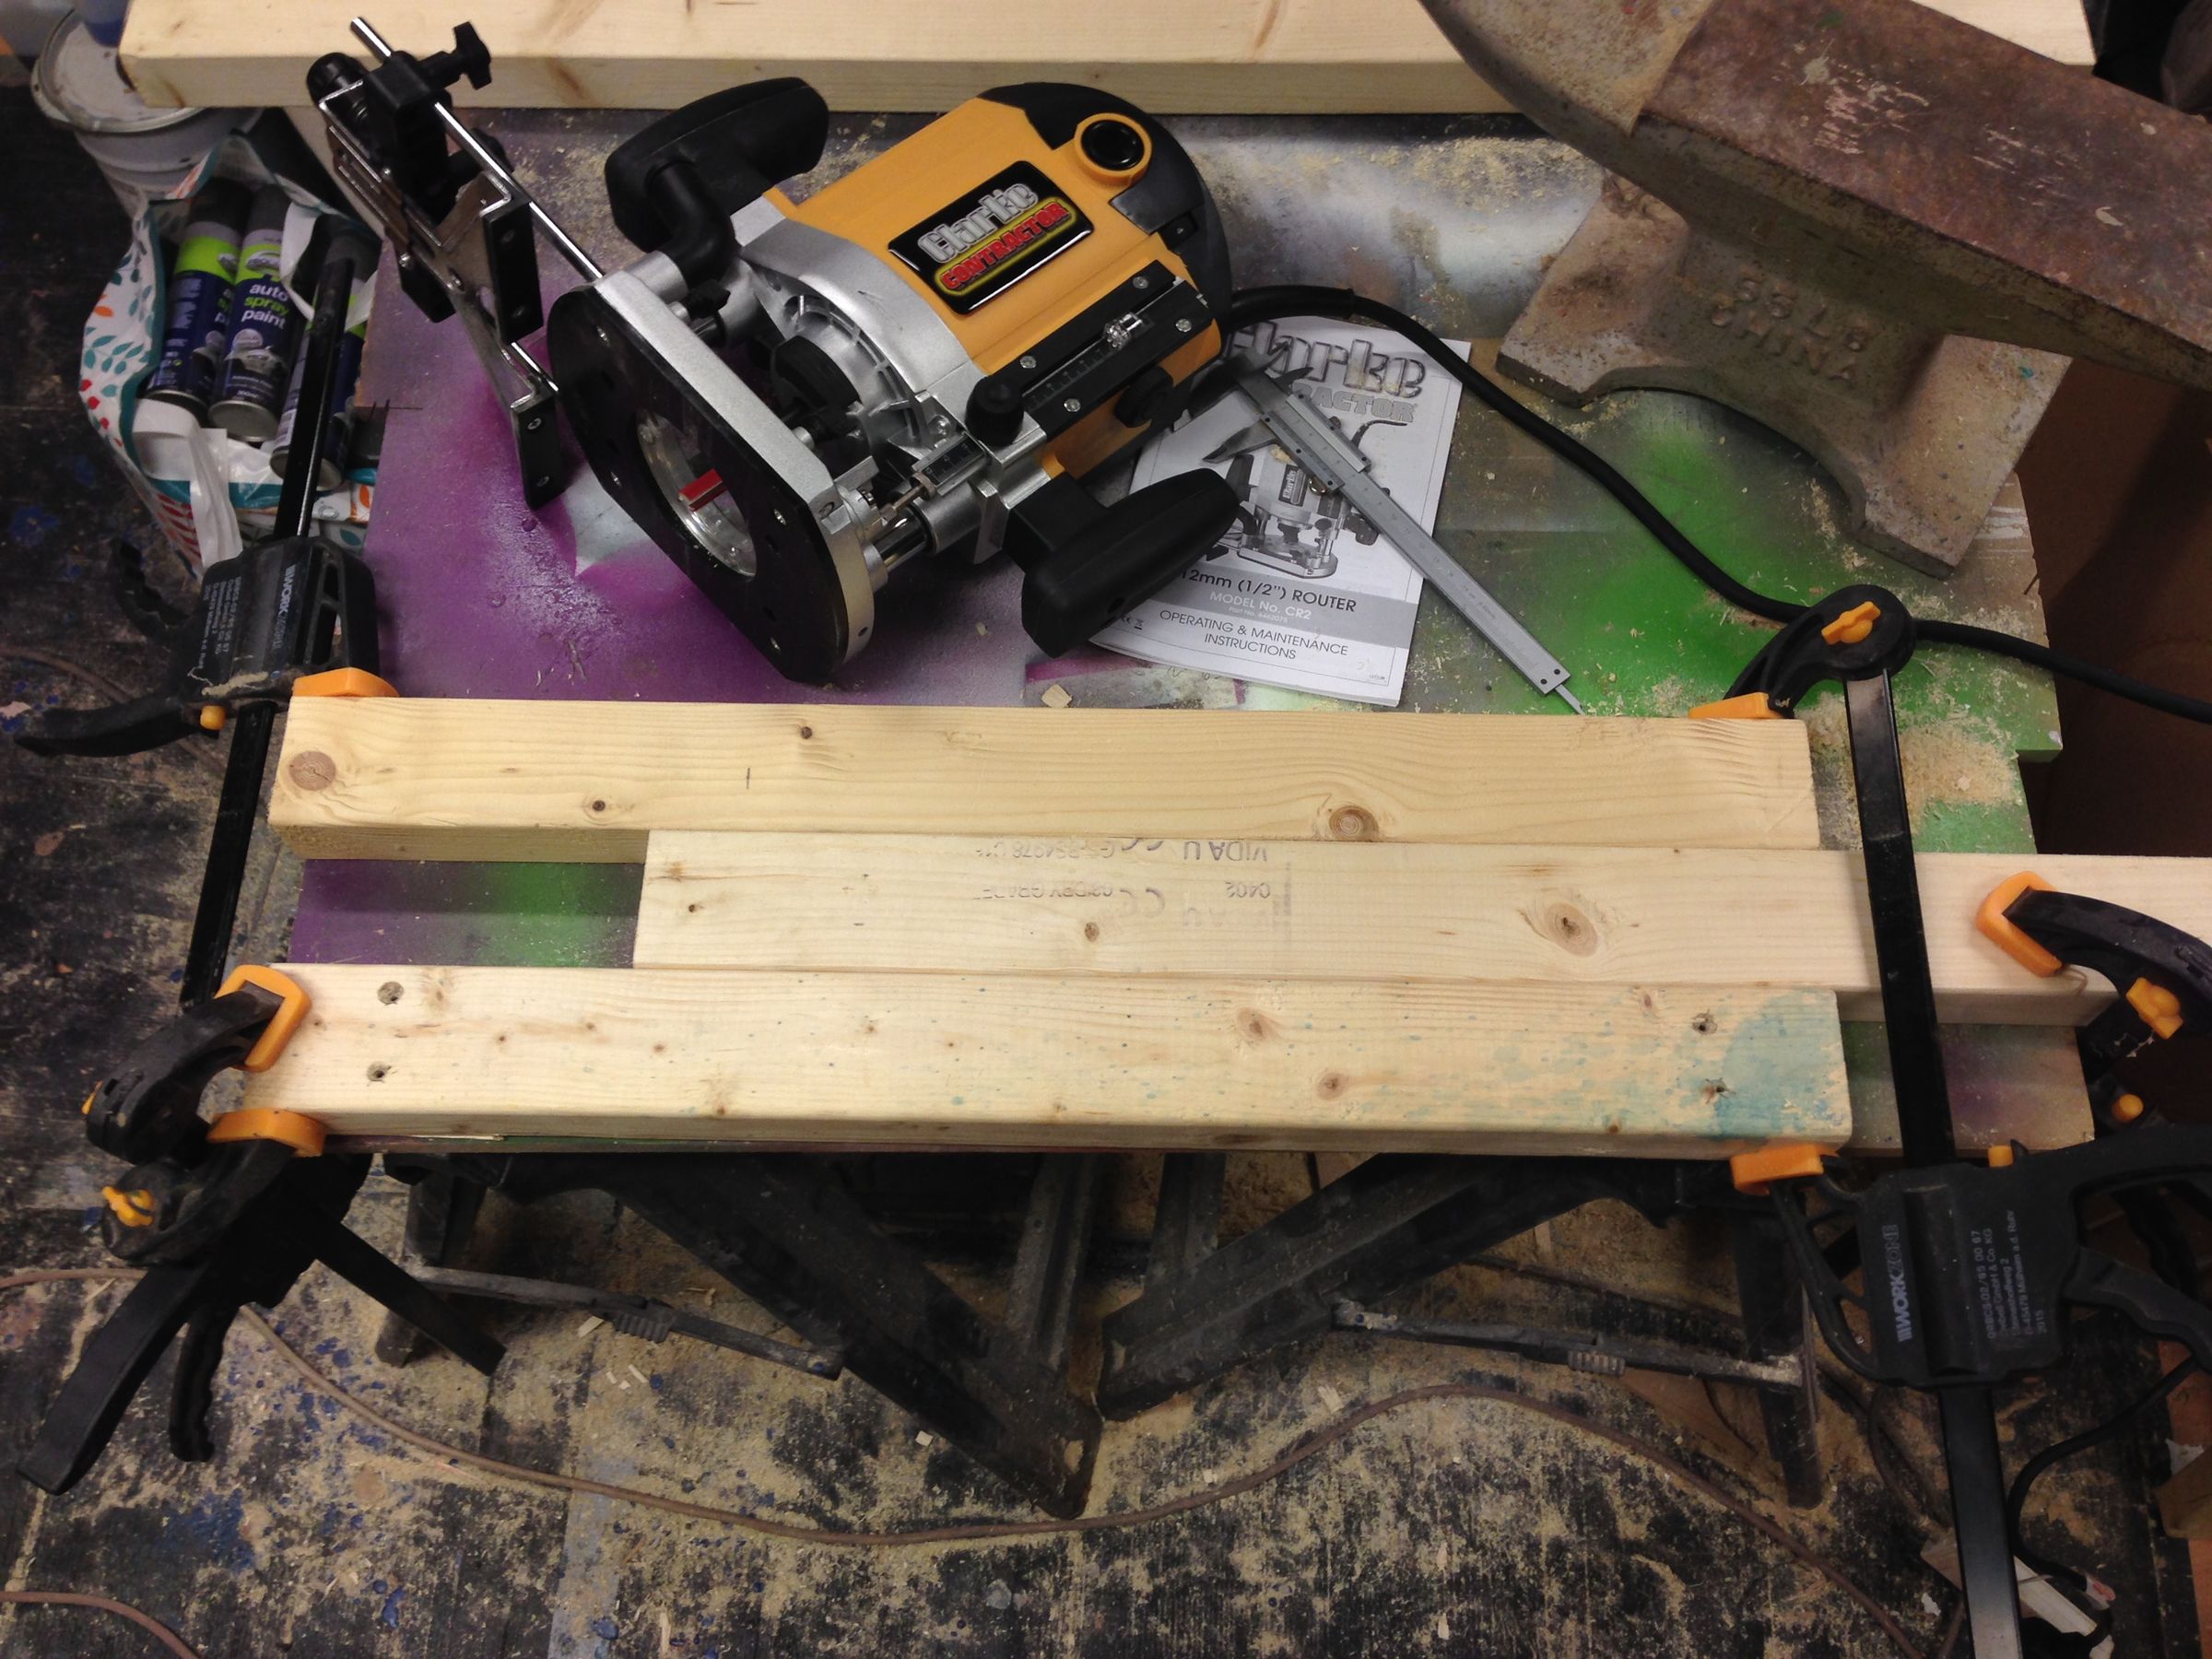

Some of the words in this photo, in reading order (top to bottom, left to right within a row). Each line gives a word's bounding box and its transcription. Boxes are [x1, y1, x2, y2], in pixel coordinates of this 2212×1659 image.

[917, 182, 1040, 264] Clarke
[940, 202, 1070, 290] CONTRACTOR
[249, 284, 288, 301] auto
[243, 296, 289, 315] spray
[241, 310, 286, 329] paint
[1210, 591, 1255, 608] MODEL
[1259, 601, 1281, 614] No.
[1285, 606, 1312, 620] CR2
[1292, 590, 1357, 612] ROUTER
[1159, 609, 1233, 632] OPERATING
[1238, 625, 1248, 635] &
[1251, 627, 1349, 656] MAINTENANCE
[1205, 633, 1296, 660] INSTRUCTIONS
[1183, 841, 1201, 861] U
[1208, 841, 1268, 862] VIDA
[1882, 1225, 1912, 1329] WORKZONE
